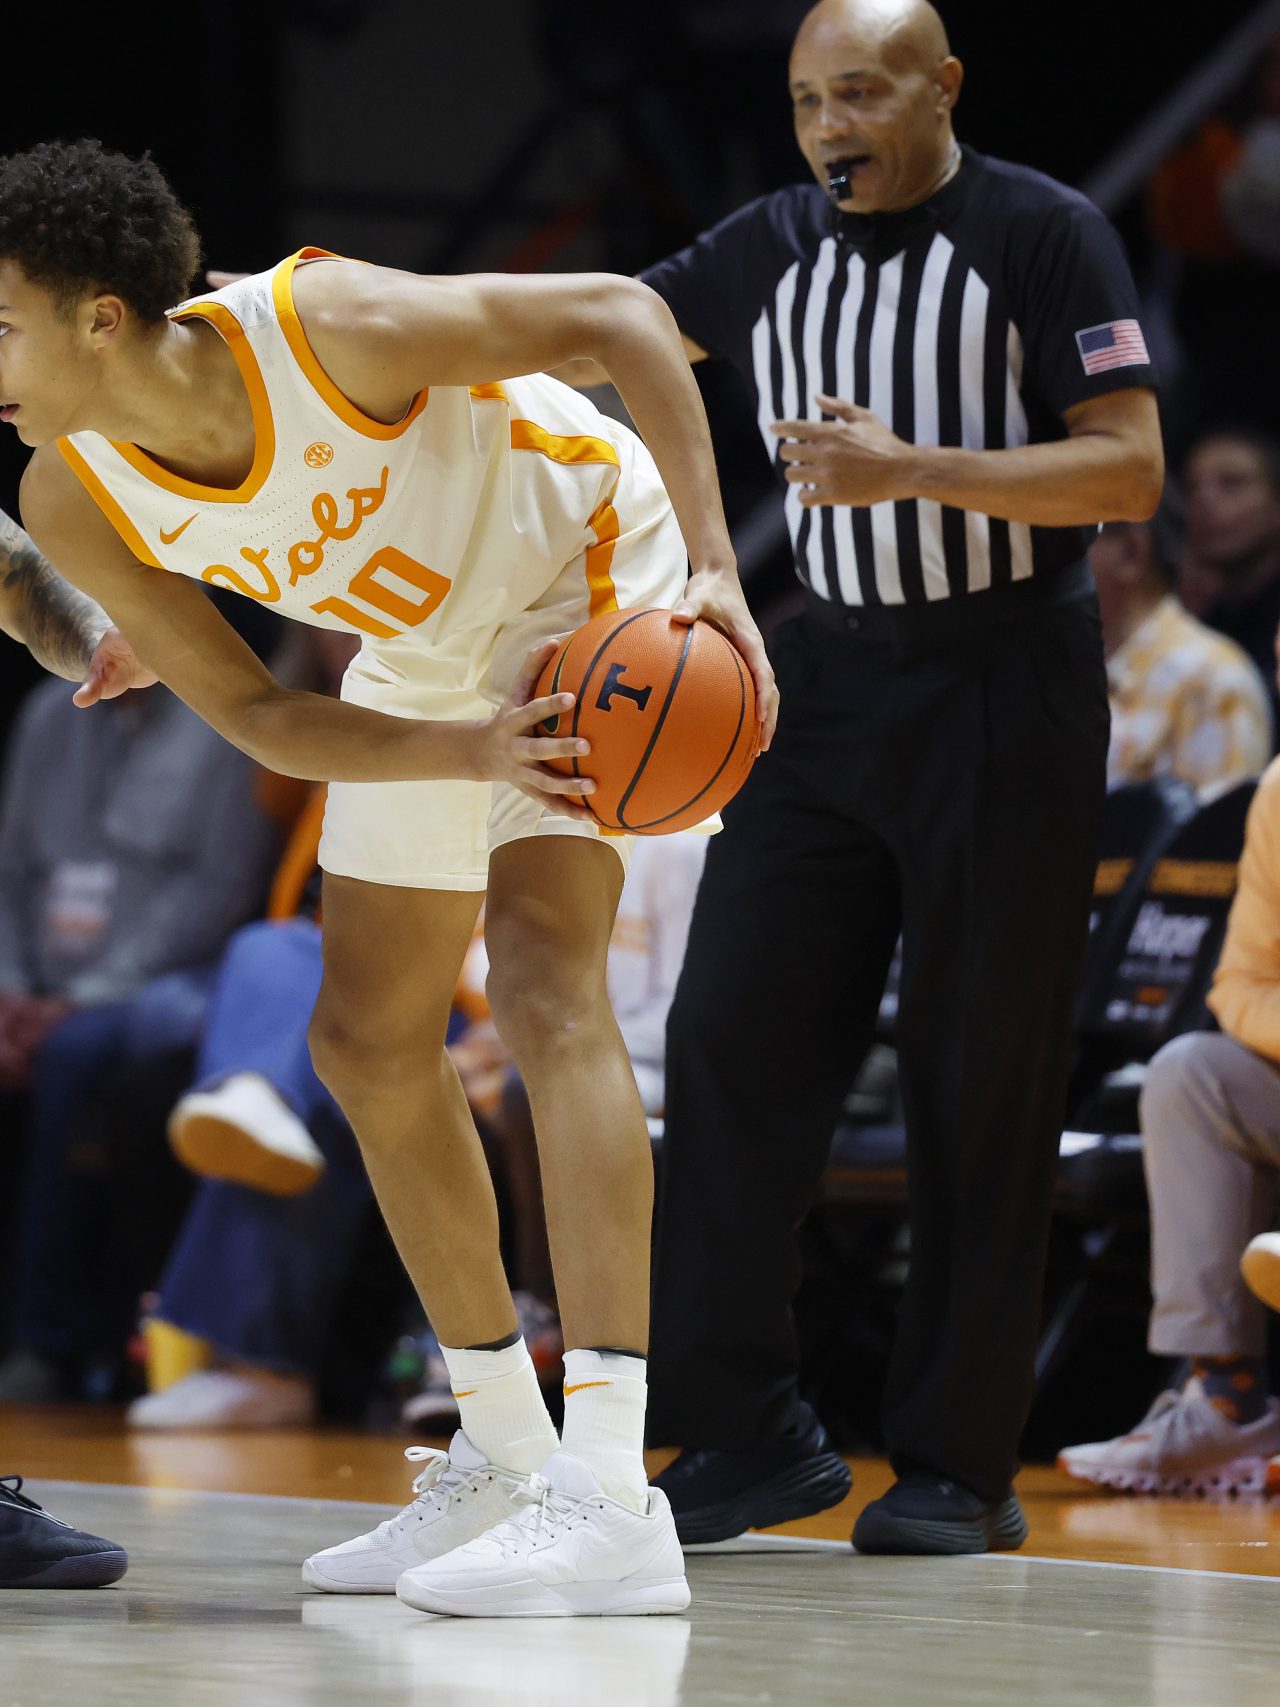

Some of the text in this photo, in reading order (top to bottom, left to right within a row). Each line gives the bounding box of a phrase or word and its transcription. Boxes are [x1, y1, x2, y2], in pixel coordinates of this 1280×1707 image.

[306, 444, 333, 467] SEC
[201, 465, 389, 603] Vols
[309, 546, 452, 639] 10
[595, 663, 653, 712] T
